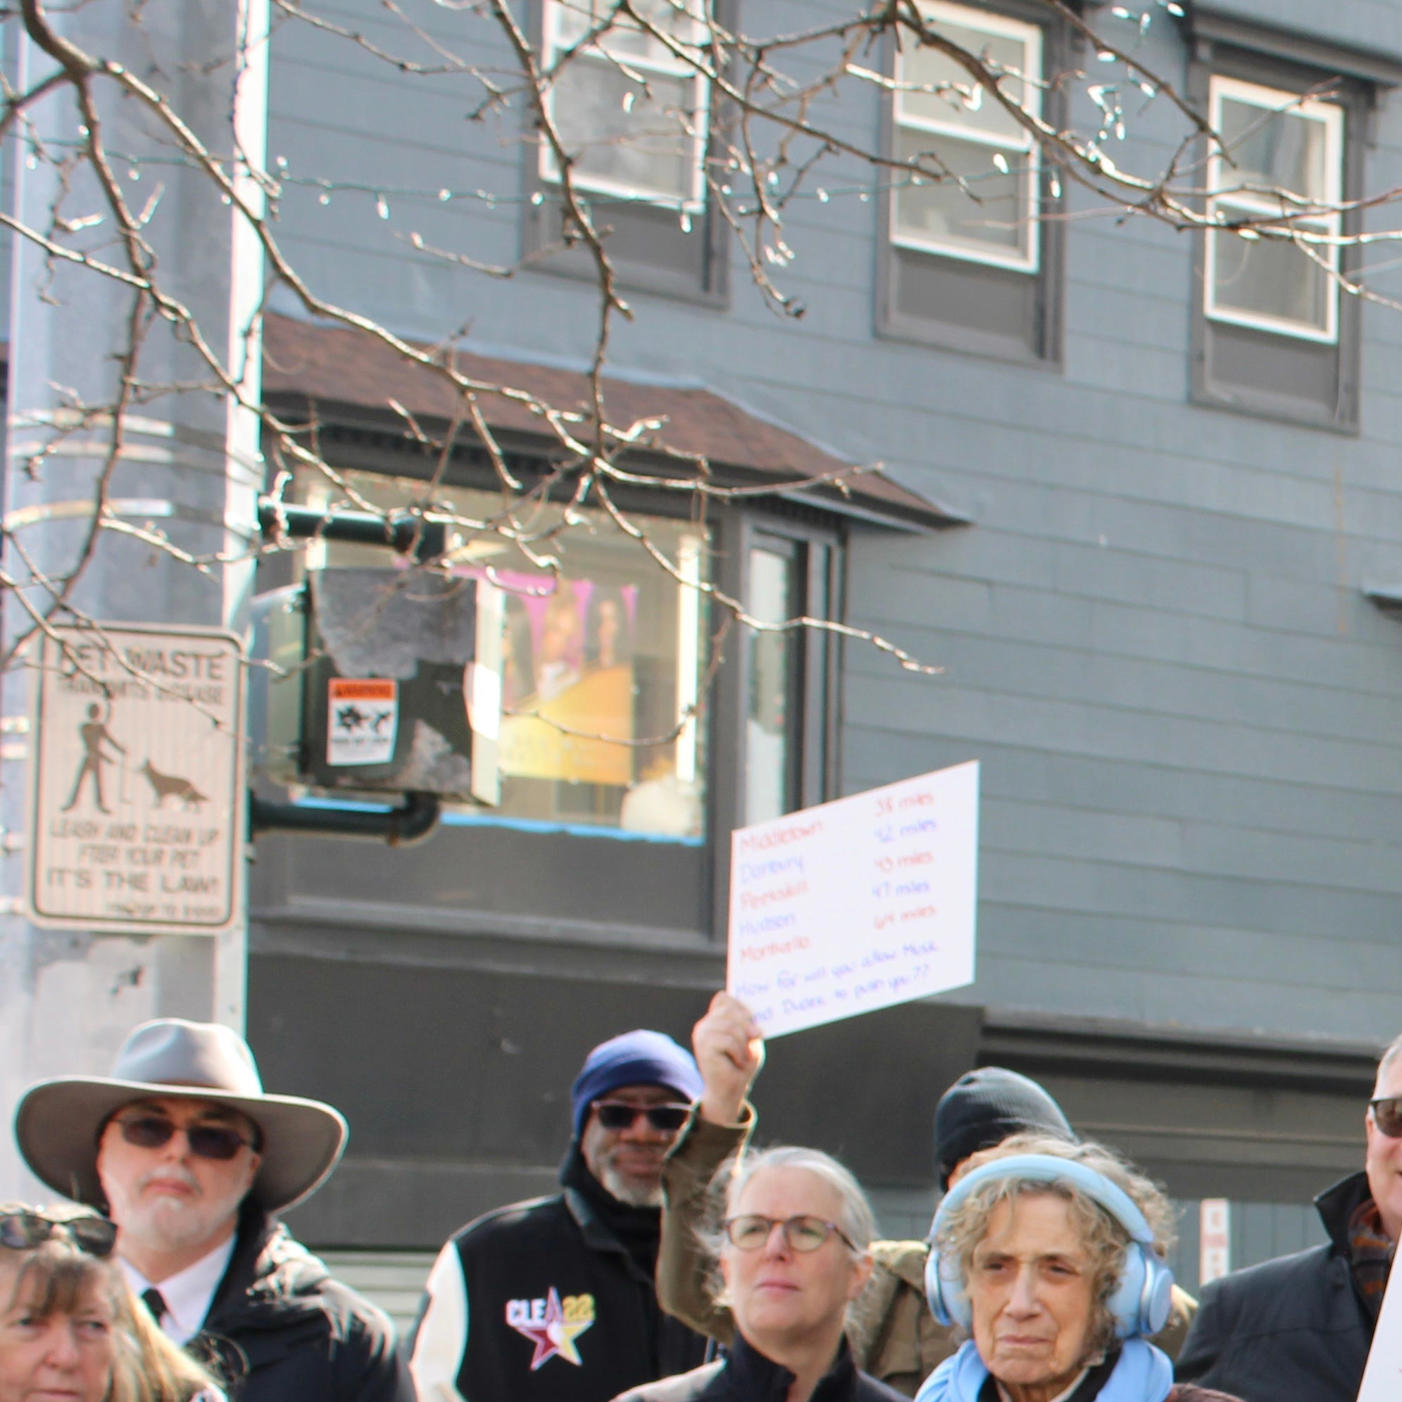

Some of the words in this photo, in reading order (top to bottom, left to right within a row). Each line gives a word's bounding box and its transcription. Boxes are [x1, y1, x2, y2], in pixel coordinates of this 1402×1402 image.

[125, 648, 225, 680] WASTE
[50, 821, 100, 841] LEASH
[106, 824, 137, 842] AND
[143, 824, 192, 845] CLEAN
[198, 827, 220, 846] UP
[104, 869, 151, 891] THE
[506, 1298, 546, 1325] CLE
[562, 1293, 595, 1322] 22
